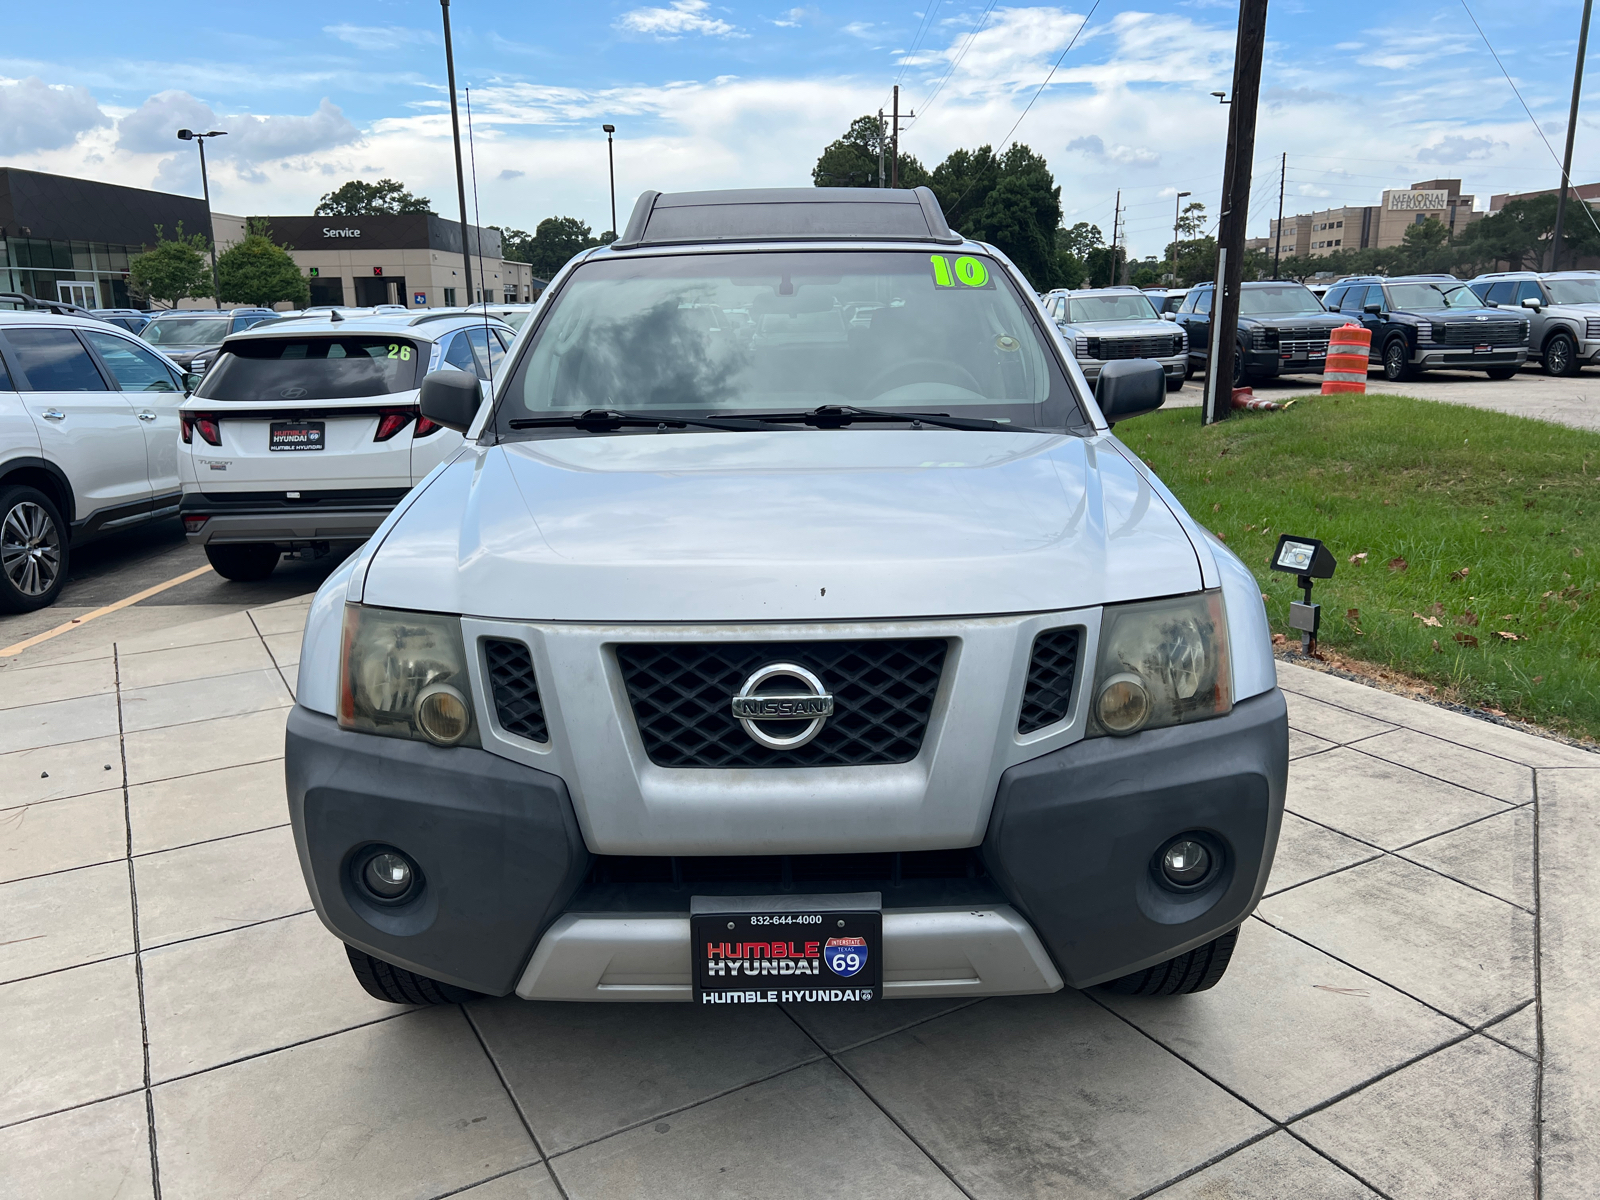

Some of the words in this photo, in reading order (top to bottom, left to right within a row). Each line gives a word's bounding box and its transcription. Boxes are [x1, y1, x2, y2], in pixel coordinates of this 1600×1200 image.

[1391, 200, 1445, 209] HERMANN
[1392, 193, 1444, 201] MEMORIAL
[323, 228, 361, 238] Service
[931, 255, 989, 287] 10
[387, 344, 411, 361] 26
[742, 700, 823, 715] NISSAN
[750, 915, 822, 925] 832-644-4000
[707, 941, 820, 959] HUMBLE
[708, 958, 820, 976] HYUNDAI
[832, 954, 860, 972] 69
[702, 990, 778, 1004] HUMBLE
[781, 989, 860, 1003] HYUNDAI
